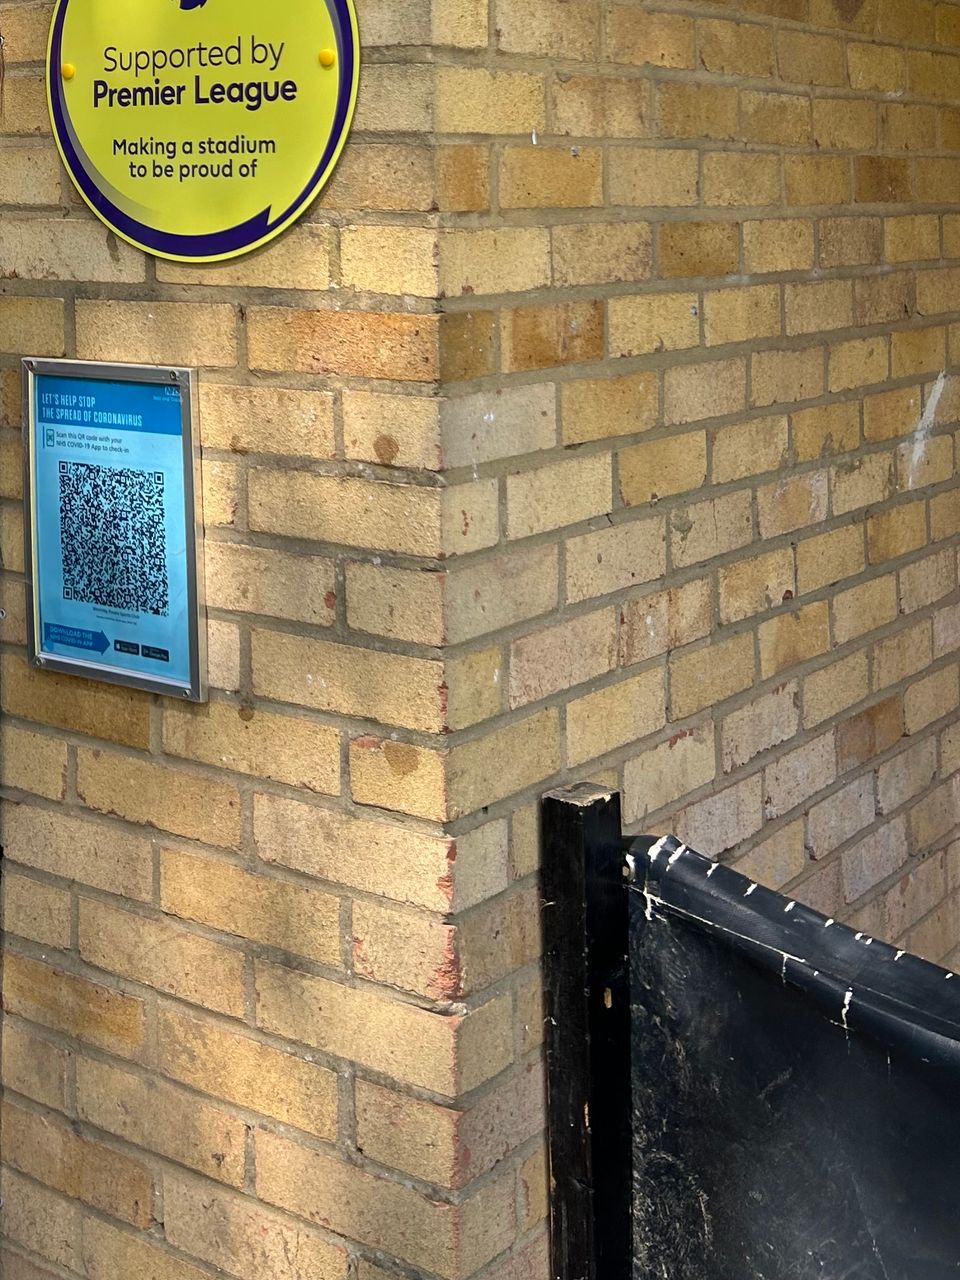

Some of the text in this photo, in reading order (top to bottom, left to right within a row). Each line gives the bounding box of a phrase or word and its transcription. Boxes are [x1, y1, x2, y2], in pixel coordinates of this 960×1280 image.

[104, 35, 285, 77] Supported by
[93, 75, 297, 111] Premier League
[112, 135, 276, 159] Making a stadium
[129, 159, 258, 182] to be proud of
[42, 393, 96, 408] LET'S HELP STOP
[42, 407, 143, 427] THE SPREAD OF CORONAVIRUS
